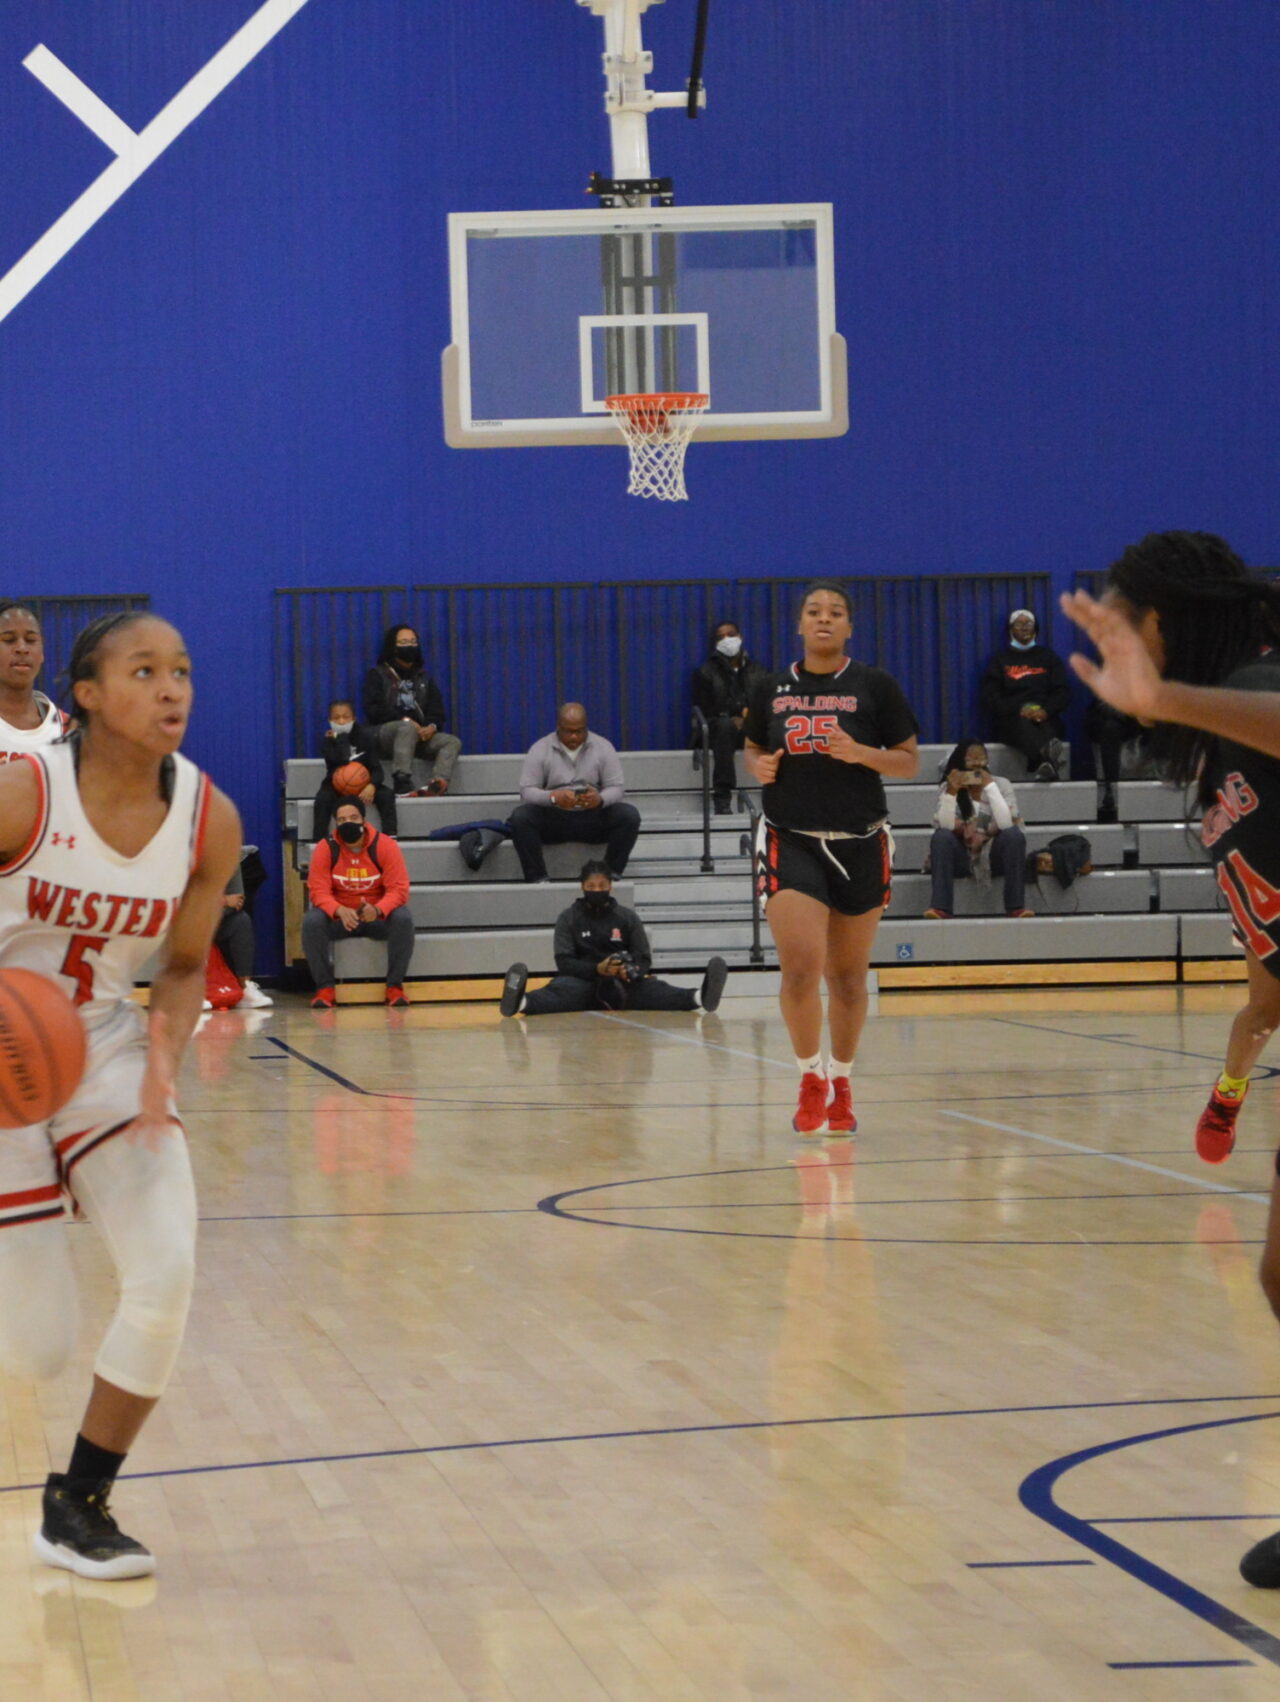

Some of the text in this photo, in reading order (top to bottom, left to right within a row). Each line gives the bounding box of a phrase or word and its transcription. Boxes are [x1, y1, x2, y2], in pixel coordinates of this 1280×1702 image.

[772, 695, 858, 714] SPALDING
[785, 715, 839, 755] 25
[28, 876, 180, 938] WESTER
[59, 934, 110, 1007] 5
